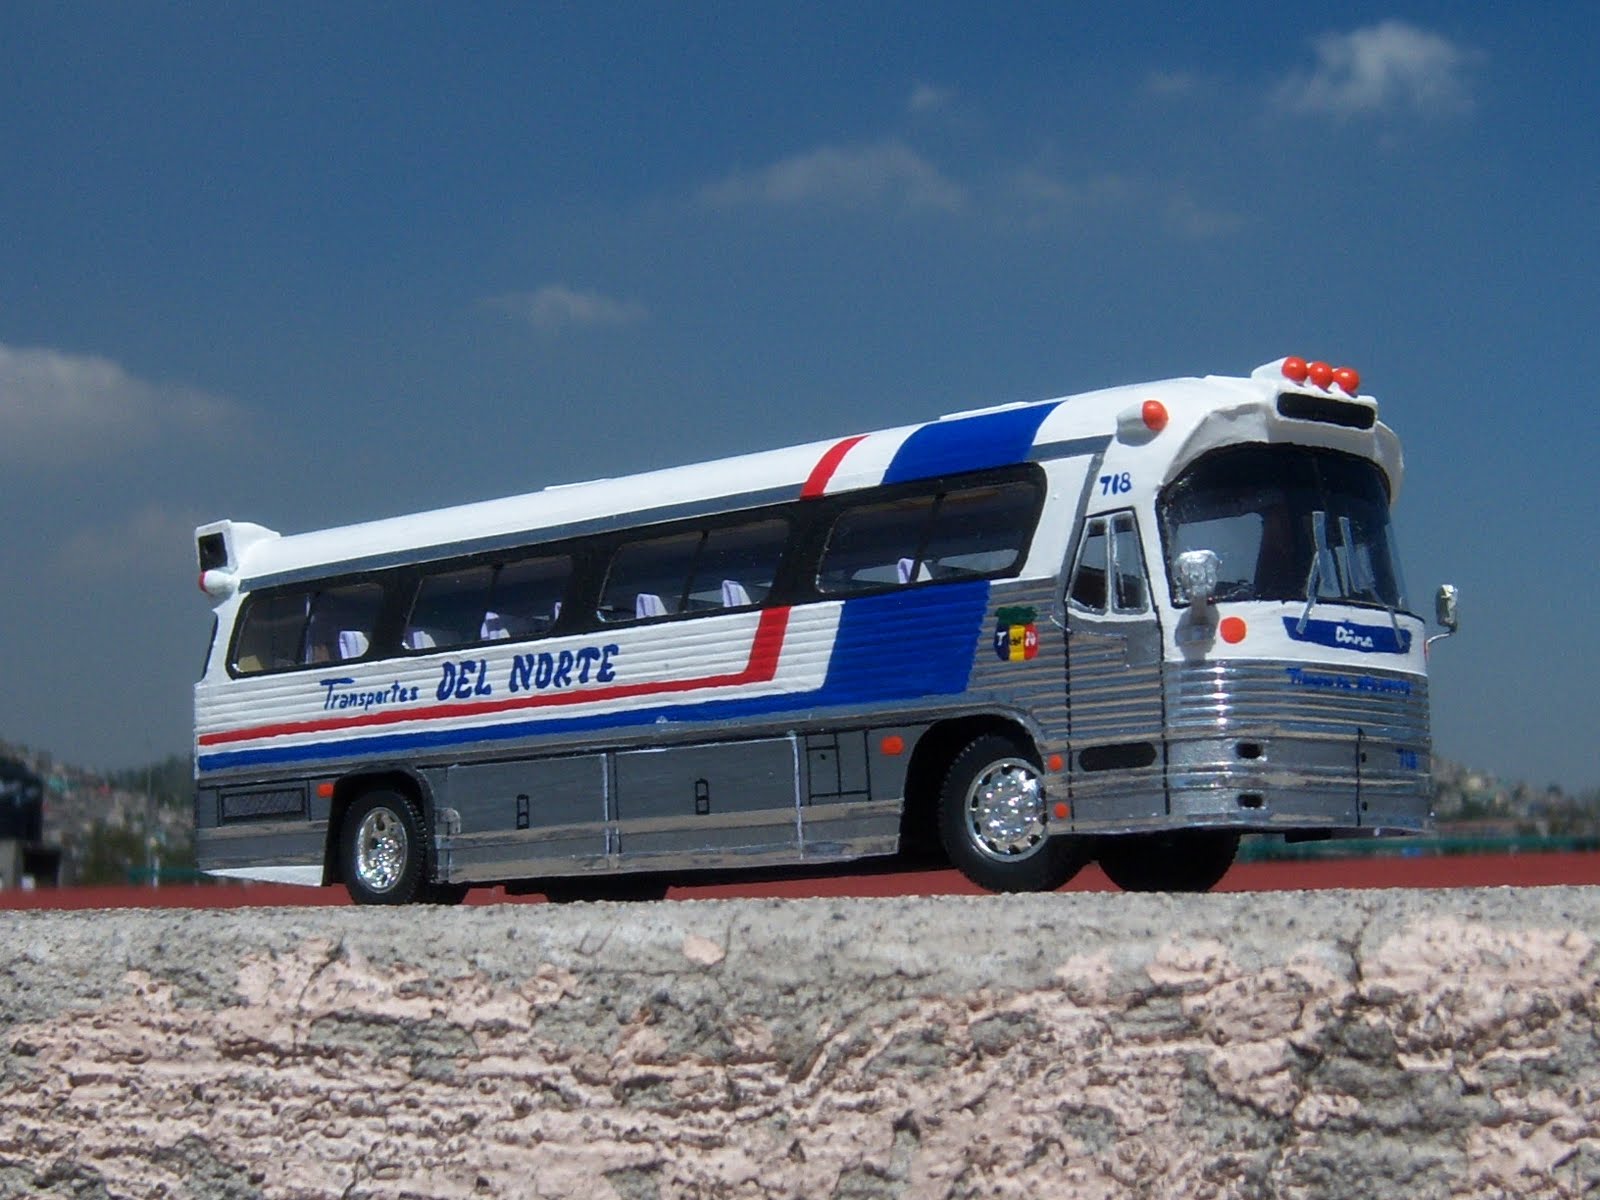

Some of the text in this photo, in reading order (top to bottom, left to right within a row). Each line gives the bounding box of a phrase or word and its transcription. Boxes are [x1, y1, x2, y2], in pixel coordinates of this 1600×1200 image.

[1100, 472, 1132, 496] 718
[996, 631, 1007, 646] T
[1335, 625, 1375, 648] Dina
[319, 643, 620, 711] Transportes DEL NORTE
